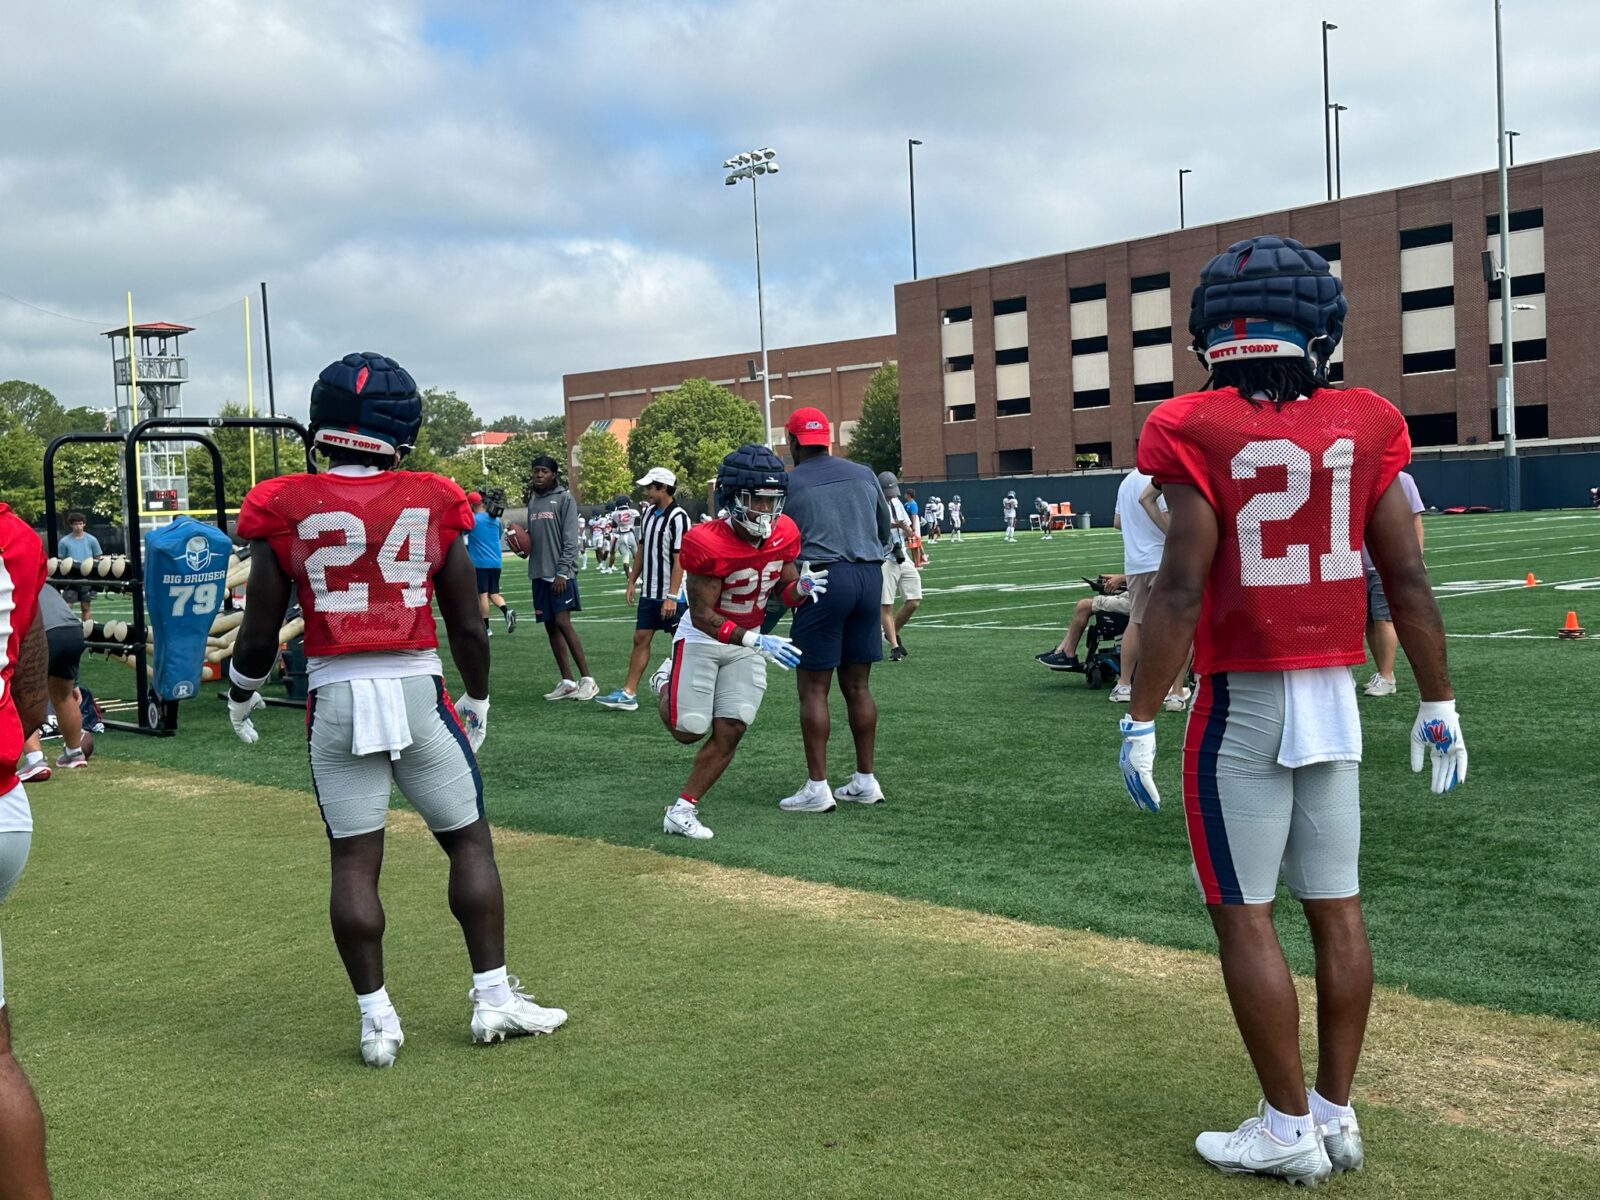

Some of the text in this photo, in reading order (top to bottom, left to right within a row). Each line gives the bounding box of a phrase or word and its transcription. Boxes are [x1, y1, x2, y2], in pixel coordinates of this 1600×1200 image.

[1240, 343, 1279, 354] TODDY
[352, 439, 381, 451] TODDY
[617, 512, 631, 523] 12
[1230, 438, 1364, 587] 21
[297, 507, 432, 614] 24
[163, 570, 226, 584] BIG BRUISER
[719, 559, 784, 614] 26
[168, 582, 218, 617] 79
[178, 685, 189, 696] R
